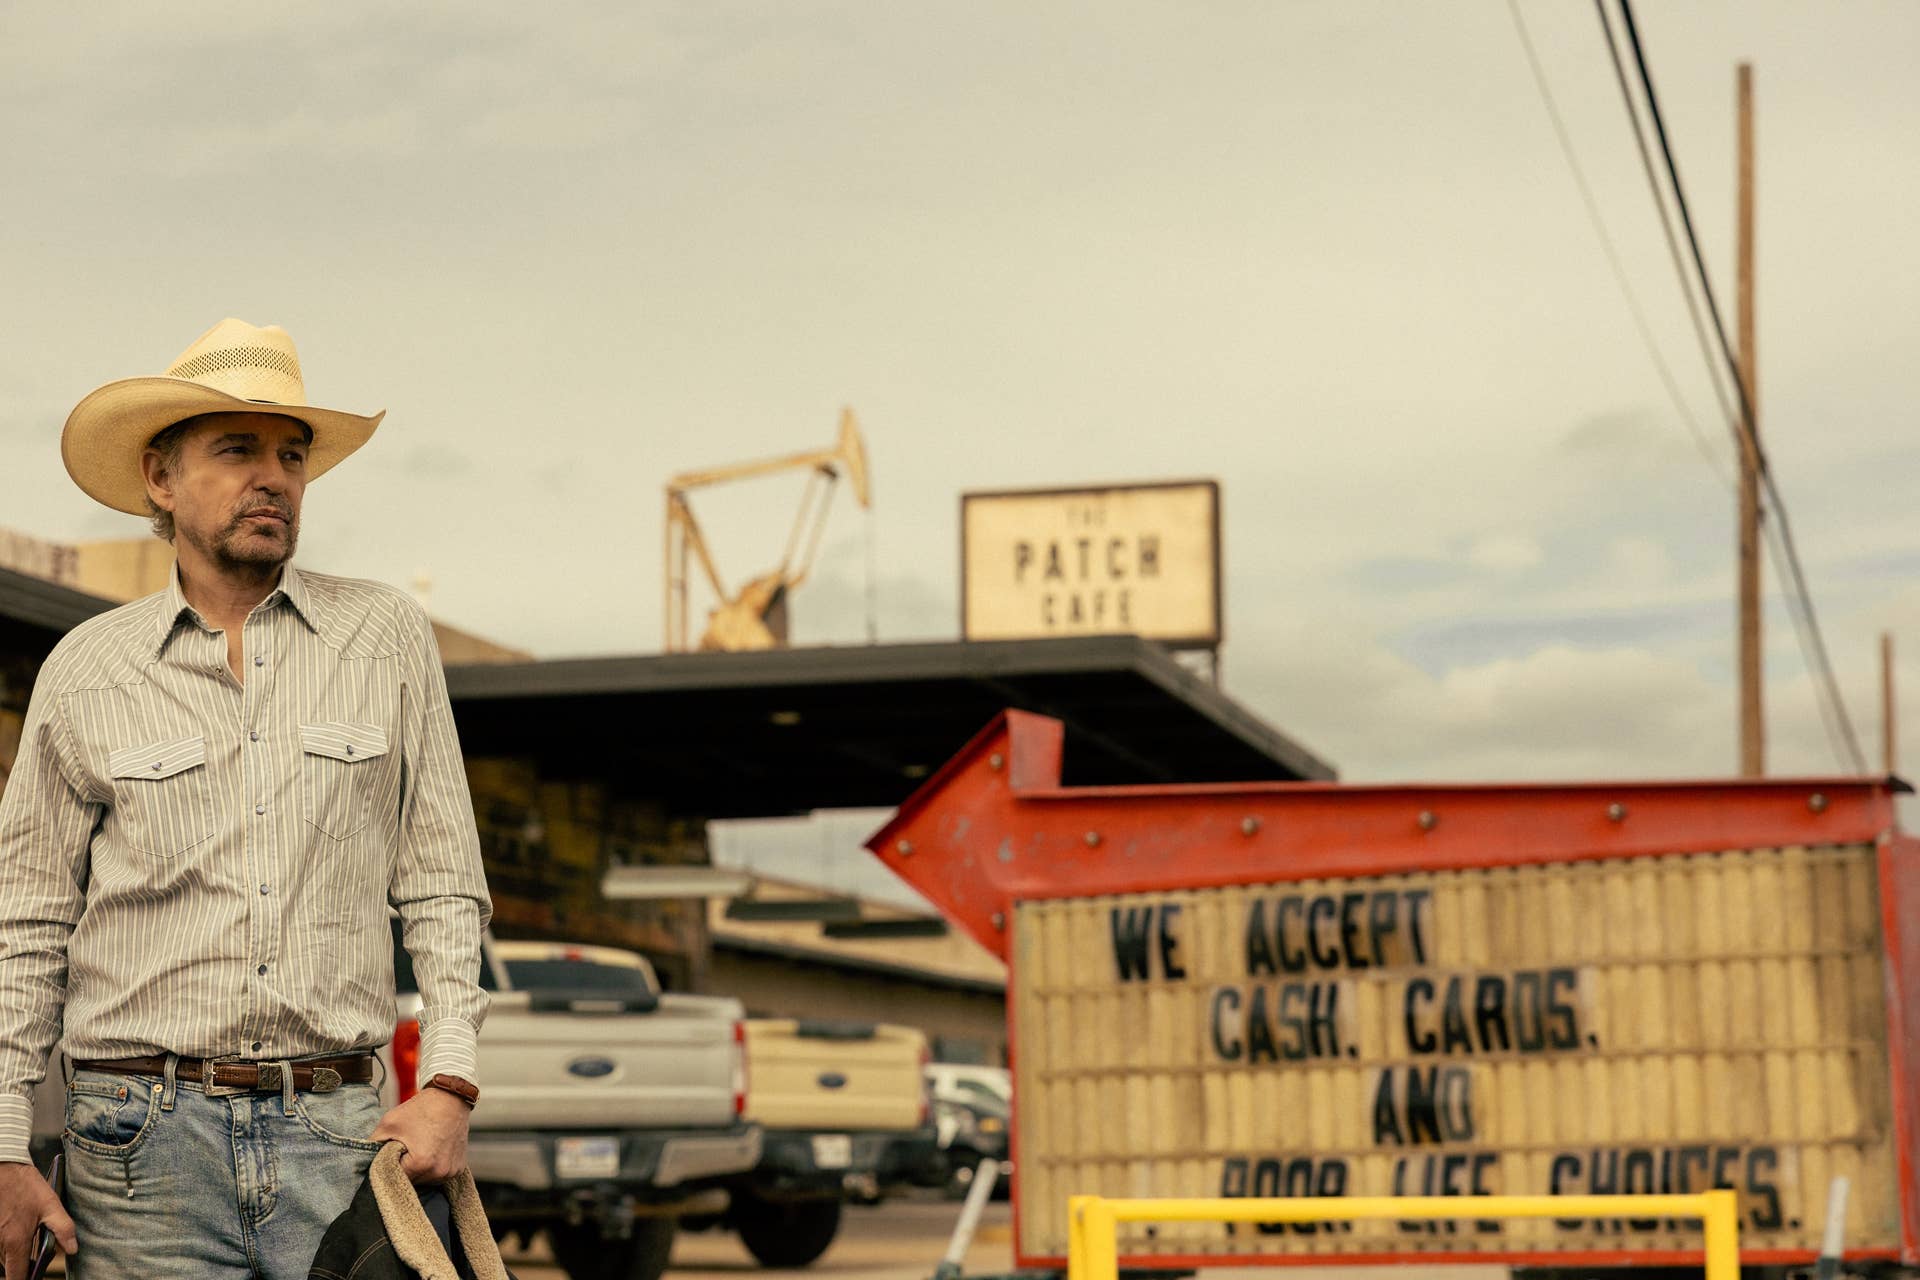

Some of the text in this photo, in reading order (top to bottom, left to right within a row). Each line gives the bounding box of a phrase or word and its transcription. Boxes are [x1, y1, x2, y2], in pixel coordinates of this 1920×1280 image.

[1014, 535, 1160, 585] PATCH
[1043, 588, 1130, 626] CAFE
[1110, 890, 1432, 981] WE ACCEPT
[1373, 1065, 1475, 1144] AND
[1222, 1157, 1352, 1235] POOR
[1393, 1154, 1500, 1234] LIFE
